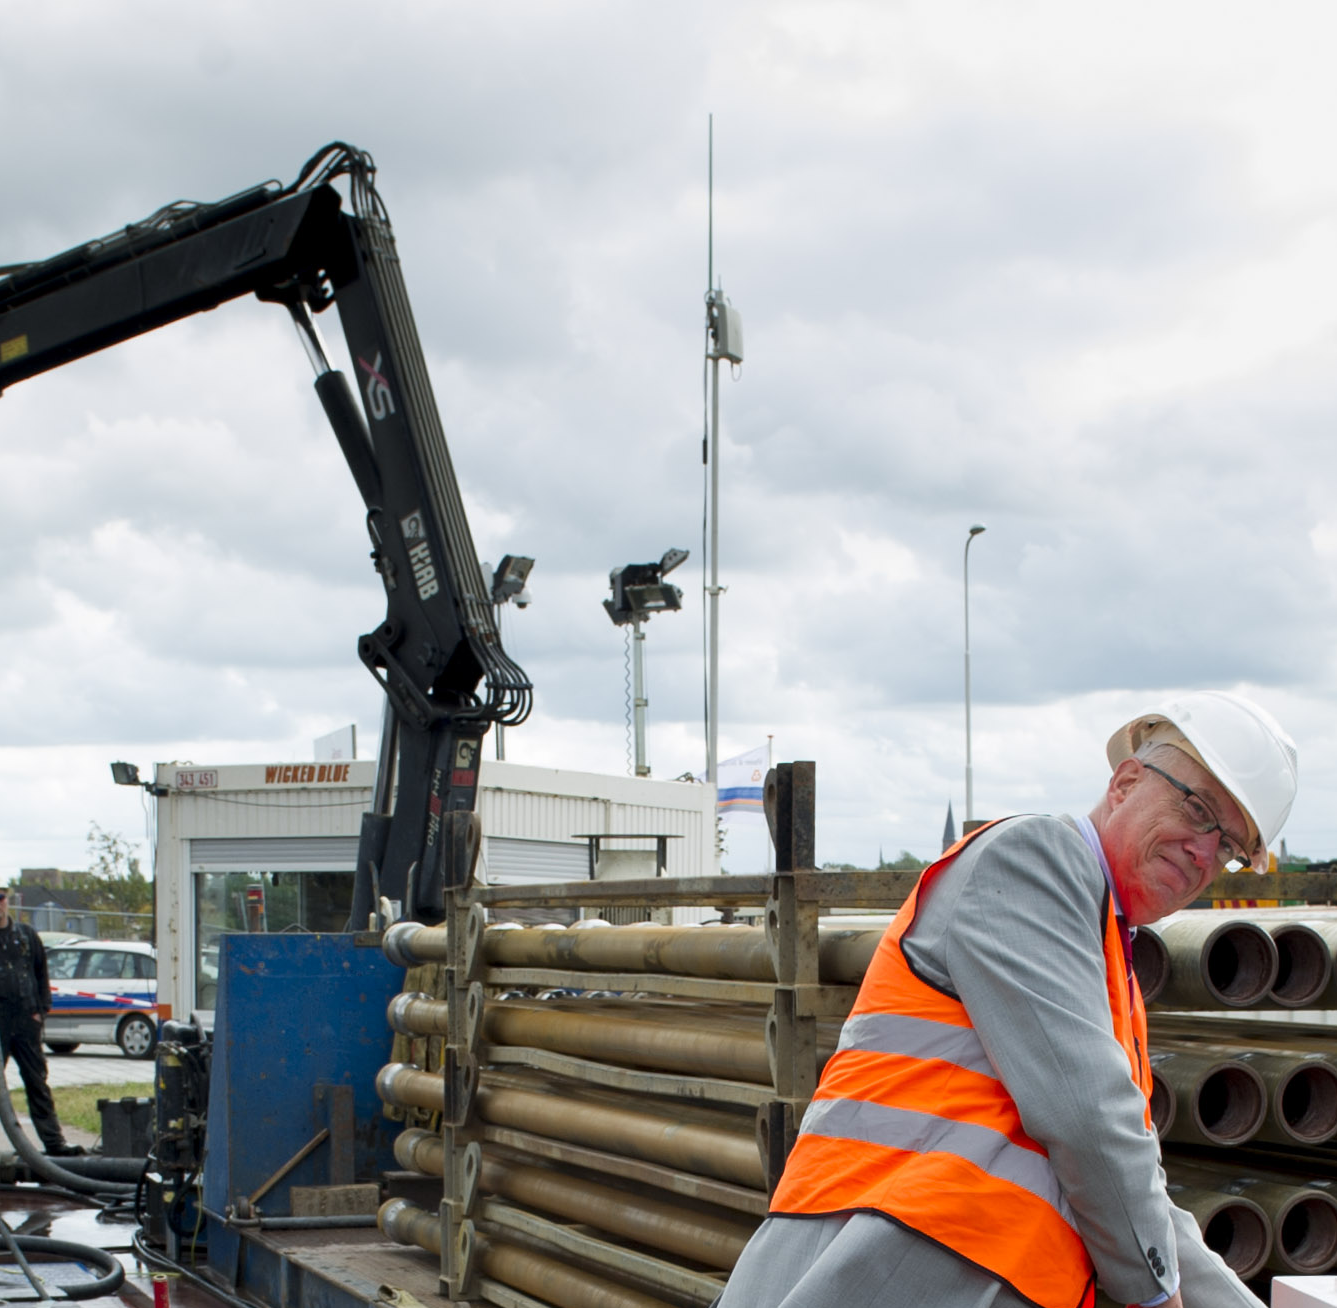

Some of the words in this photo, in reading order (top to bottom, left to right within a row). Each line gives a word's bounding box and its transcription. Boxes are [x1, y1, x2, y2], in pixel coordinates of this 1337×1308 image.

[358, 351, 396, 421] XS
[409, 541, 439, 601] HIAB
[265, 764, 315, 784] WICKED
[317, 763, 350, 783] BLUE
